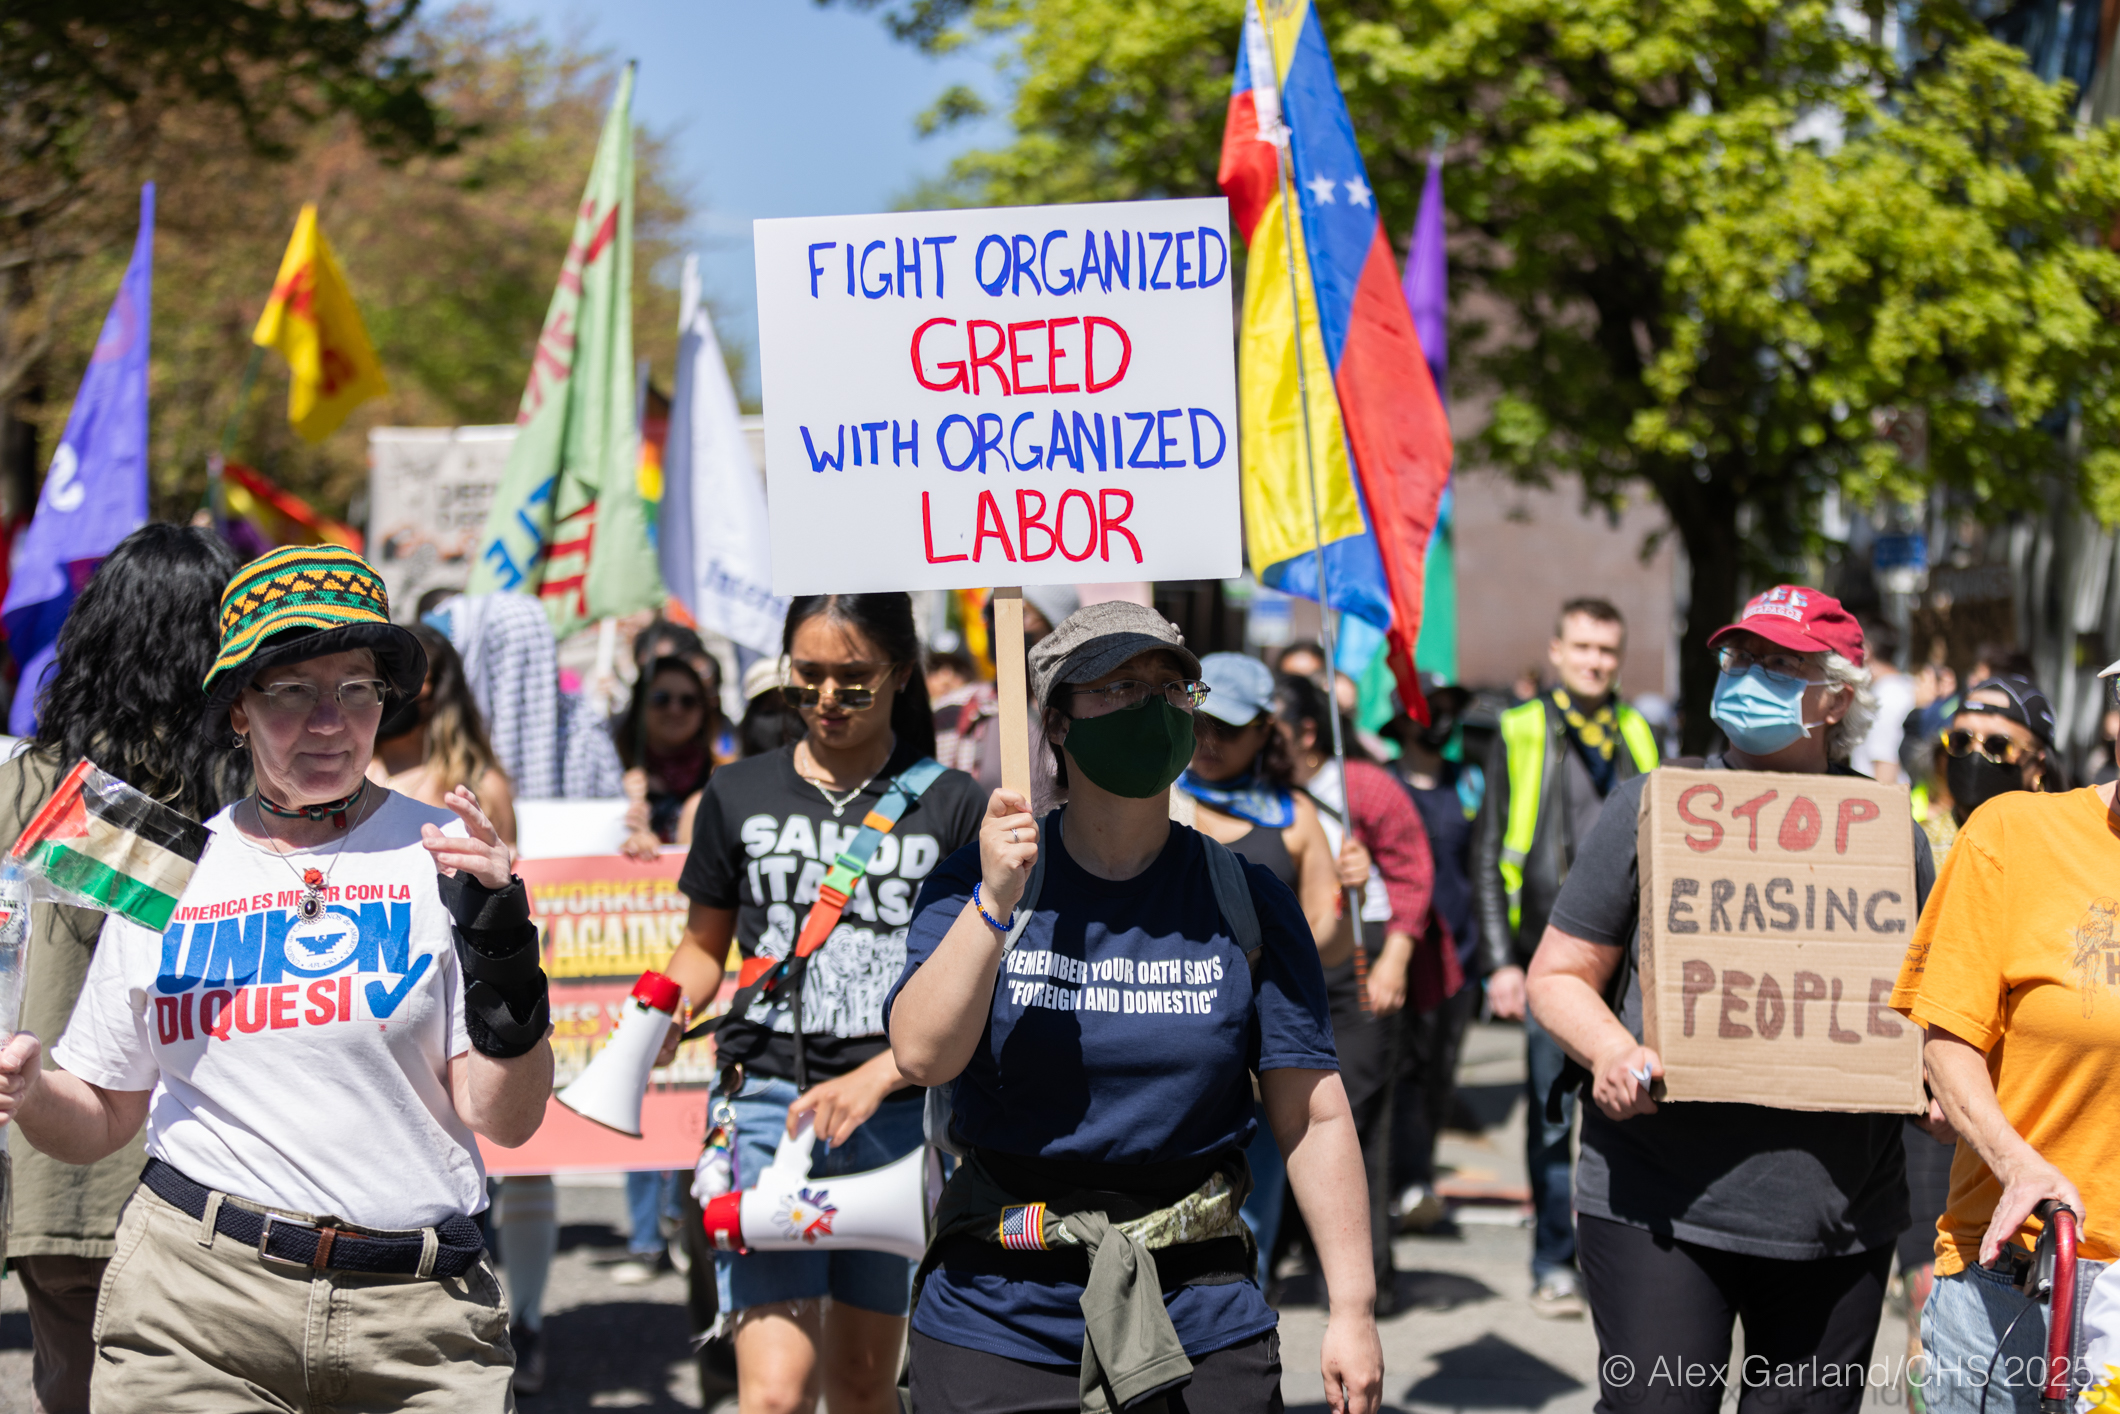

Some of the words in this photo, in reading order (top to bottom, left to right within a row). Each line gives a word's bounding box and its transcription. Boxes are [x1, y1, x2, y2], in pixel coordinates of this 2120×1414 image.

[809, 235, 957, 299] FIGHT
[975, 226, 1228, 297] ORGANIZED
[910, 316, 1132, 396] GREED
[800, 419, 919, 473] WITH
[936, 408, 1227, 474] ORGANIZED
[922, 488, 1144, 564] LABOR
[741, 813, 940, 880] SAHOD
[1677, 783, 1880, 854] STOP
[252, 893, 273, 910] ES
[345, 884, 383, 900] CON
[388, 884, 411, 900] LA
[1667, 877, 1906, 934] ERASING
[156, 901, 411, 995] UNION
[1006, 949, 1088, 985] REMEMBER
[1091, 956, 1135, 984] YOUR
[1138, 959, 1181, 985] OATH
[1184, 955, 1223, 985] SAYS
[155, 993, 195, 1045] DI
[200, 984, 299, 1041] QUE
[305, 975, 351, 1026] SI
[1008, 979, 1082, 1011] "FOREIGN
[1085, 987, 1120, 1013] AND
[1123, 988, 1218, 1014] DOMESTIC"
[1682, 959, 1904, 1044] PEOPLE
